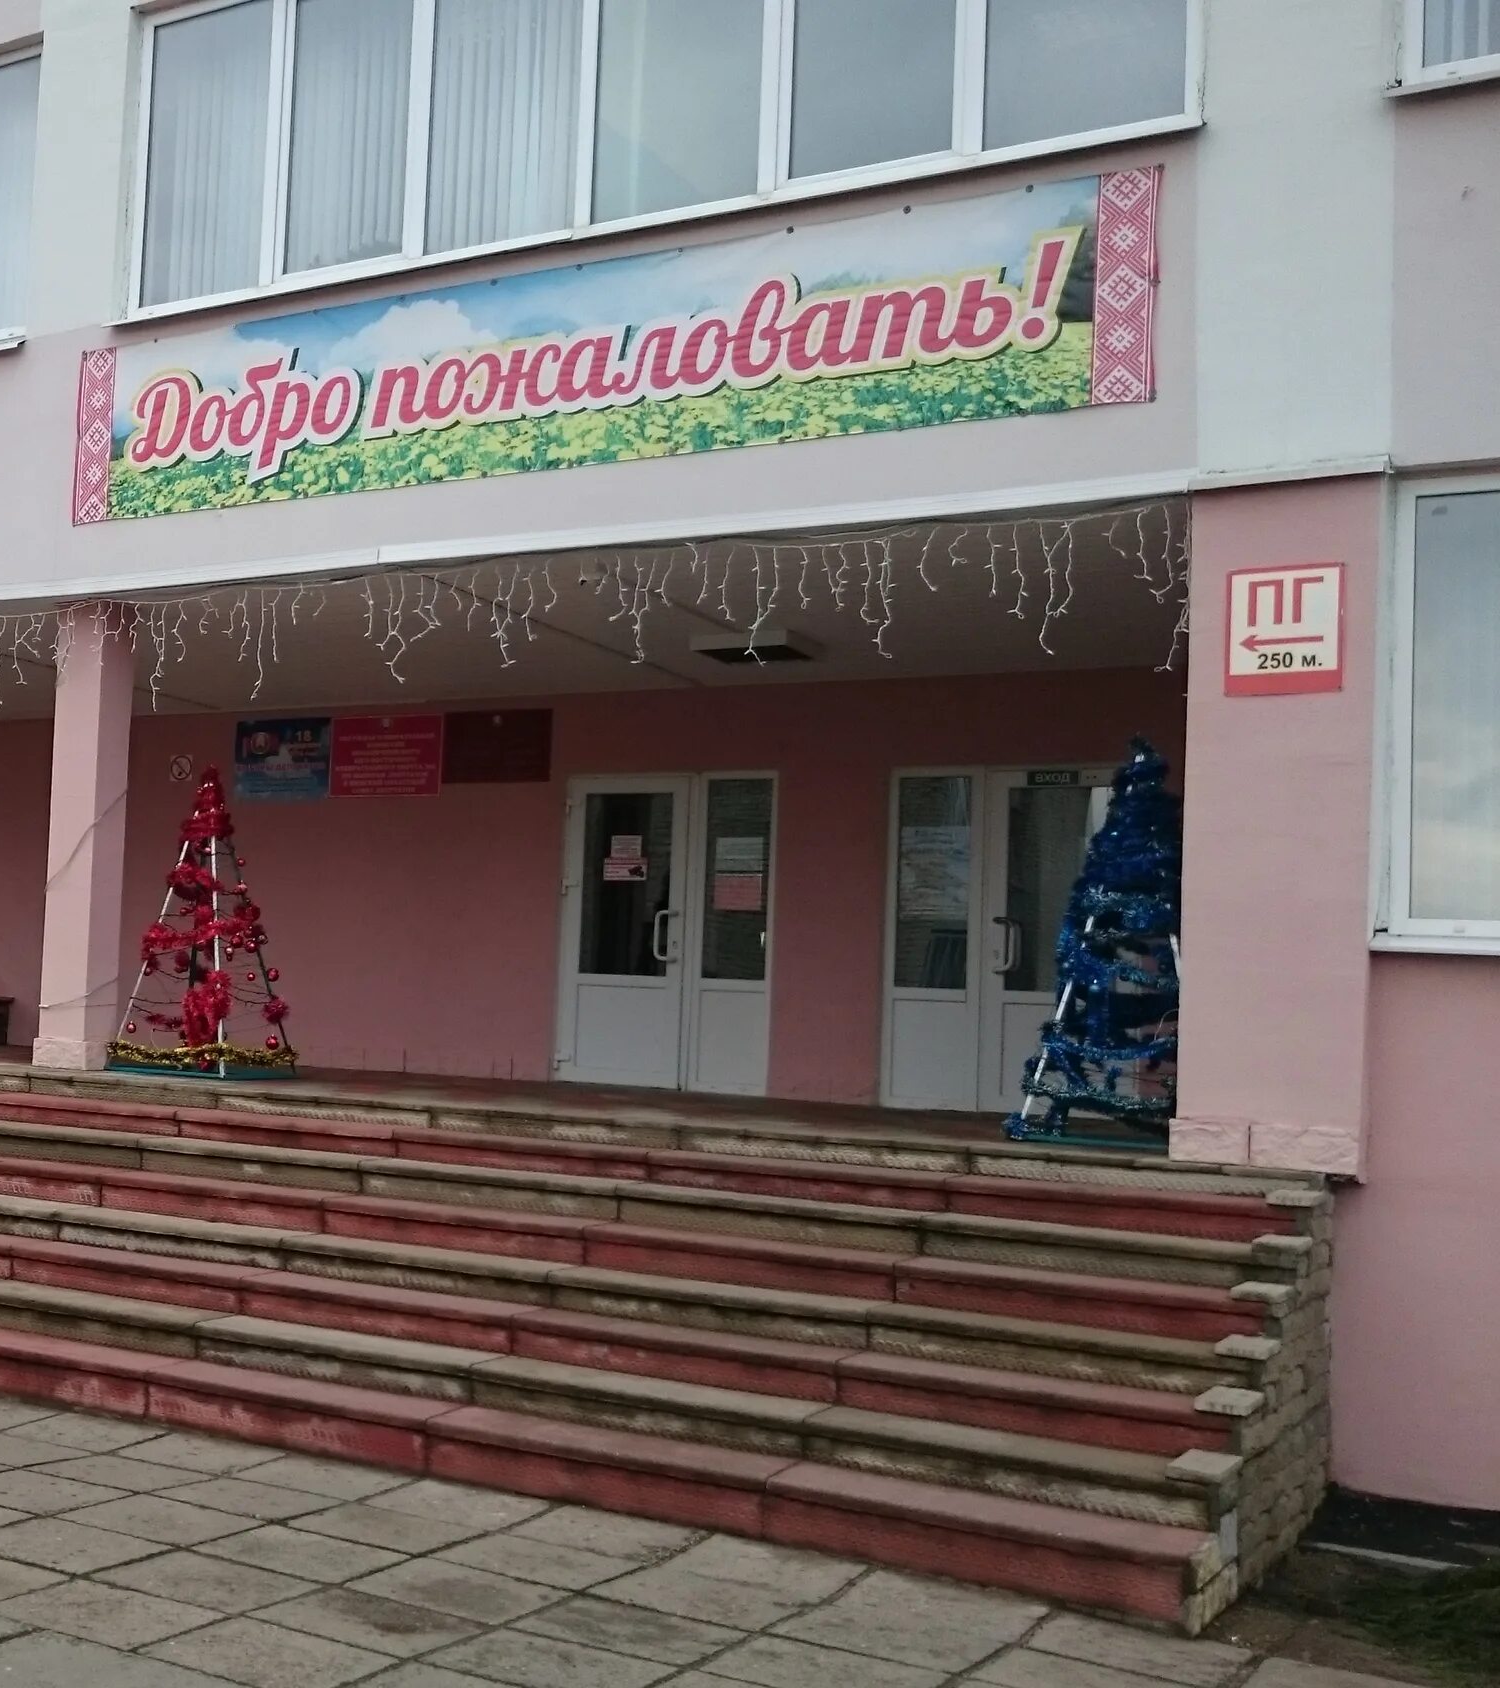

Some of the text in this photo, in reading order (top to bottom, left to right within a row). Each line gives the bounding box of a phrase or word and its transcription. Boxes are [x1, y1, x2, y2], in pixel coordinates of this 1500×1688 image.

[131, 240, 1066, 470] Добро пожаловать!
[1247, 575, 1324, 628] ПГ
[1257, 651, 1293, 670] 250
[1034, 771, 1071, 784] ВХОД
